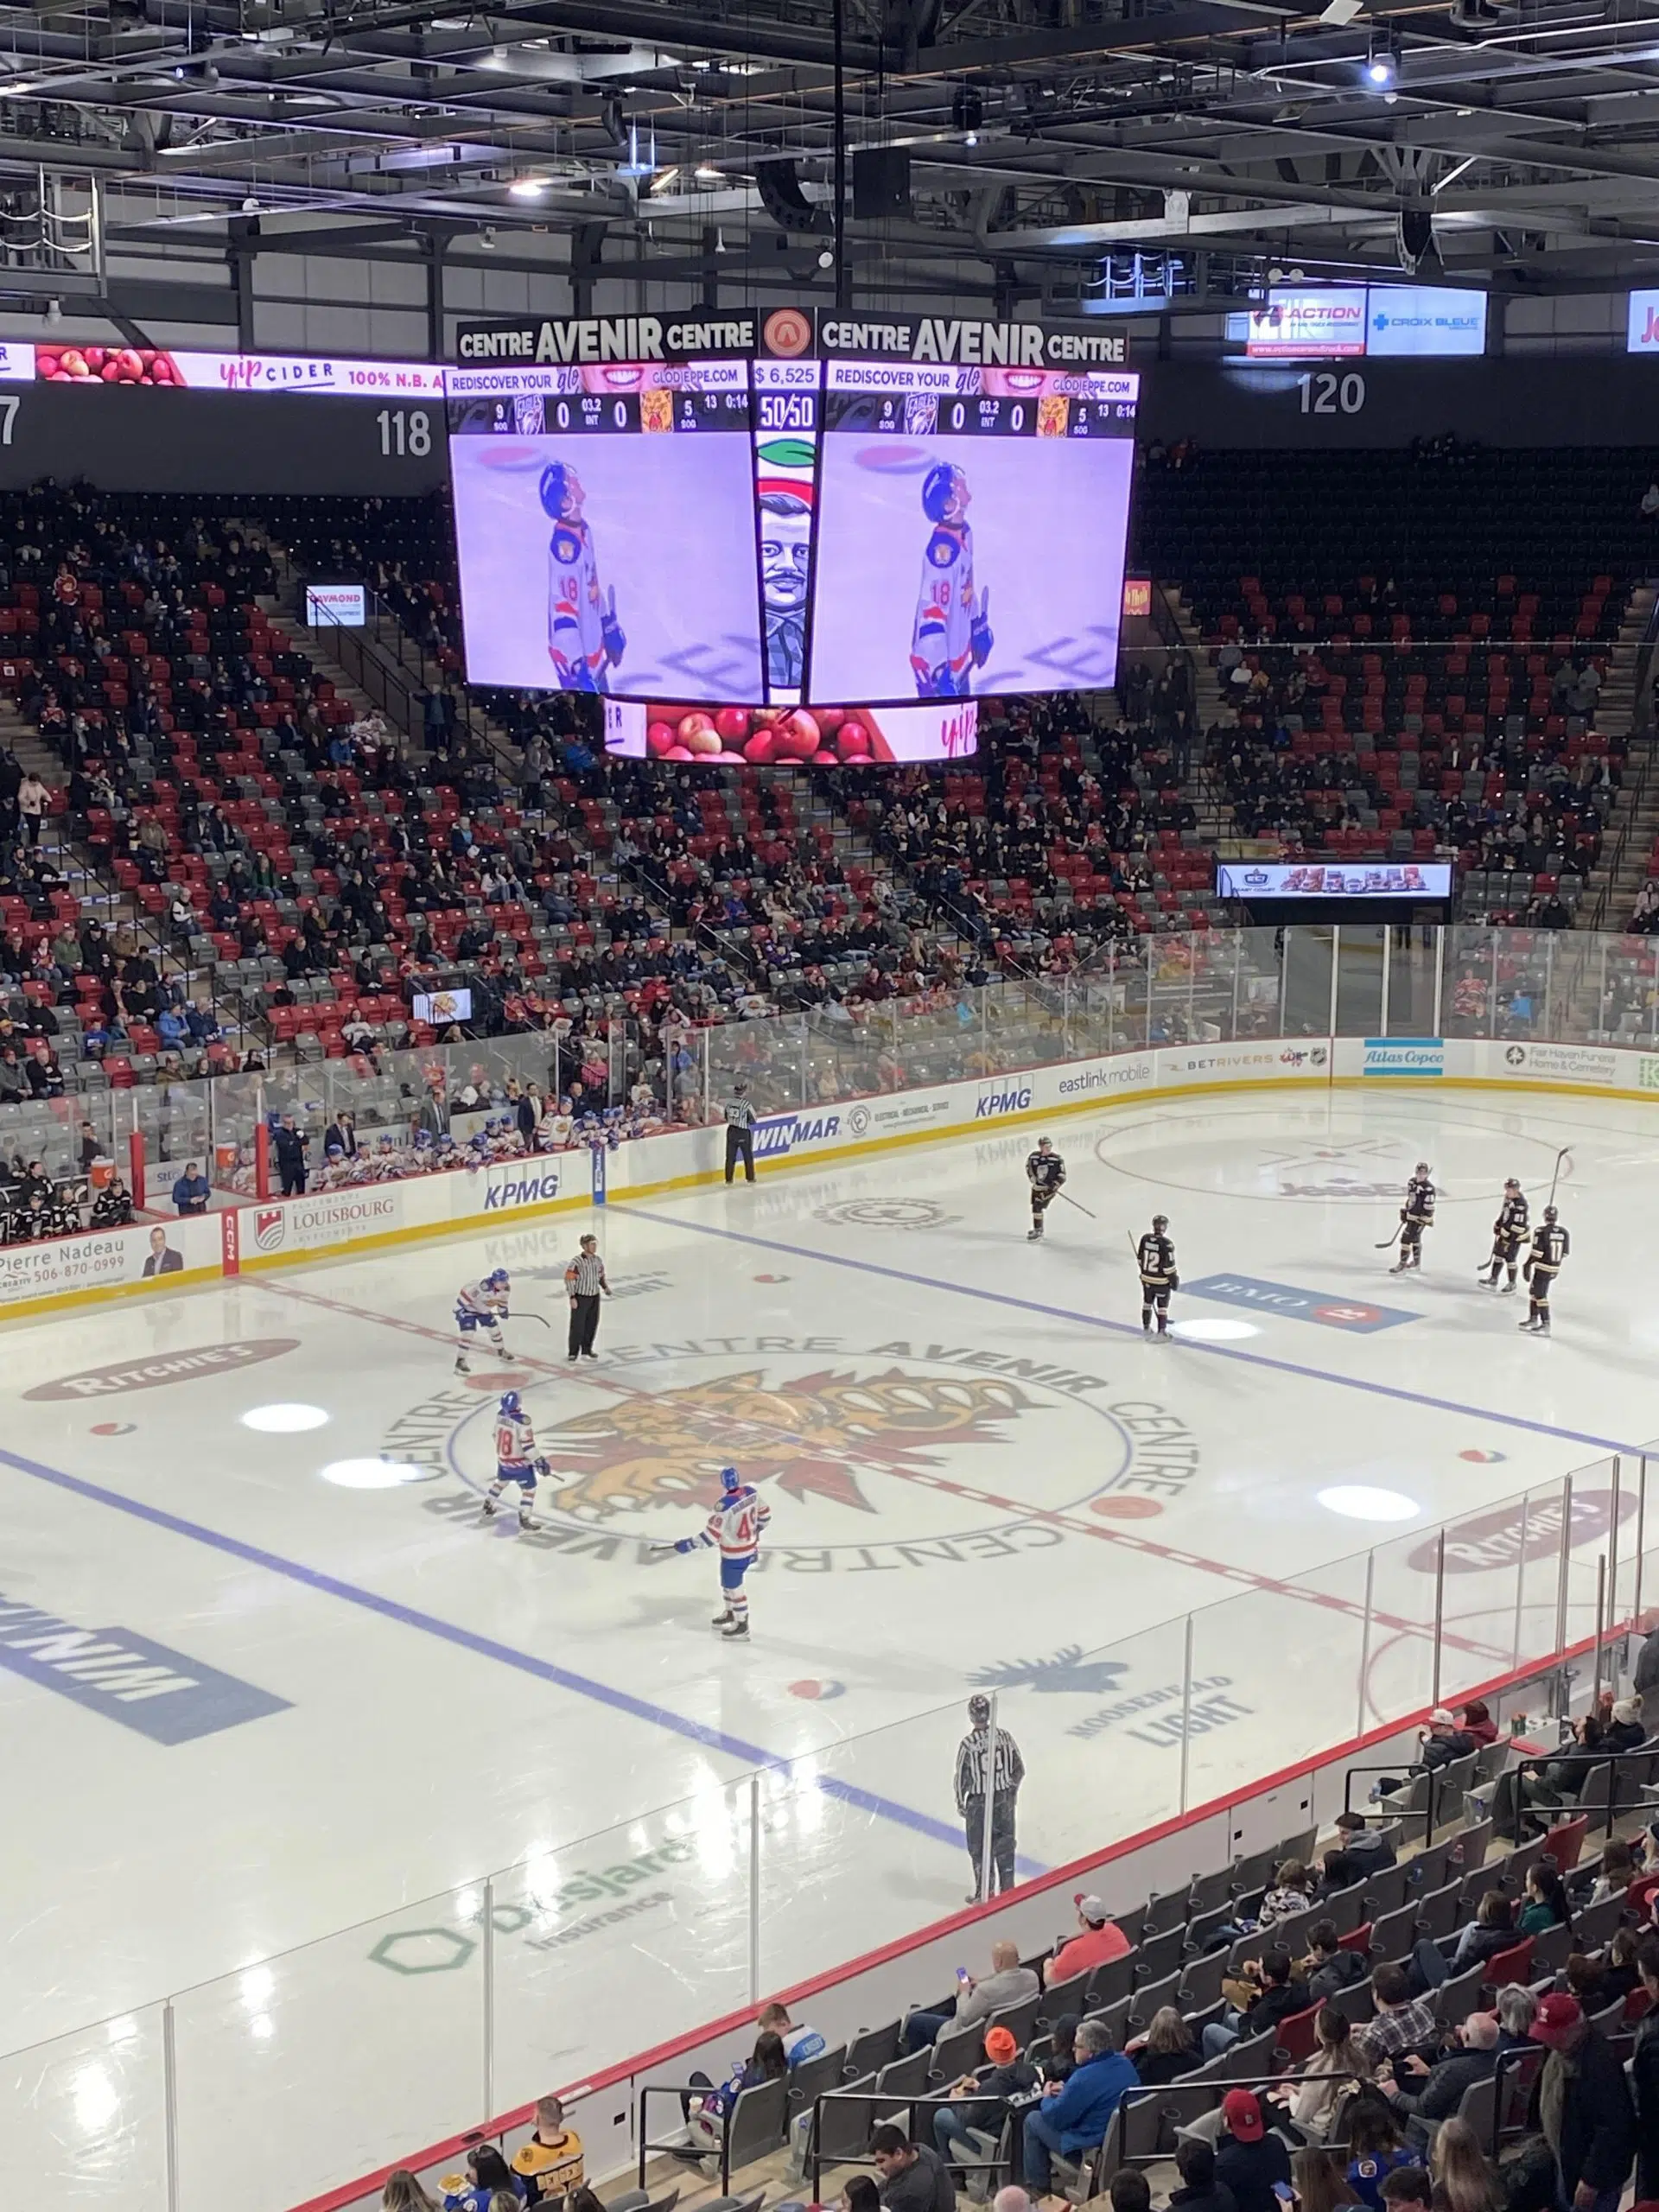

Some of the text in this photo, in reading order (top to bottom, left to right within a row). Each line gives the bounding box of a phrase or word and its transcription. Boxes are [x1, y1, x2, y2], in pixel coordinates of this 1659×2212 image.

[1287, 307, 1362, 319] ACTION
[1391, 317, 1433, 327] CROIX
[1641, 306, 1659, 343] J
[460, 316, 753, 363] CENTRE AVENIR CENTRE
[822, 318, 1124, 365] CENTRE AVENIR CENTRE
[266, 363, 334, 382] CIDER
[348, 371, 391, 387] 100%
[395, 374, 428, 389] N.B.
[452, 375, 519, 390] REDISCOVER
[521, 374, 551, 388] YOUR
[769, 367, 815, 386] 6,525
[835, 369, 914, 386] REDISCOVER
[917, 372, 950, 387] YOUR
[704, 394, 717, 409] 13
[1297, 372, 1366, 414] 120
[495, 404, 504, 420] 9
[556, 402, 569, 429] 0
[614, 401, 626, 428] 0
[684, 400, 693, 416] 5
[760, 394, 814, 430] 50/50
[883, 400, 893, 416] 9
[951, 402, 965, 429] 0
[1011, 404, 1024, 431] 0
[1078, 408, 1087, 423] 5
[377, 410, 431, 457] 118
[560, 575, 578, 601] 18
[931, 582, 950, 605] 18
[1187, 1053, 1274, 1071] BETRIVERS
[1365, 1050, 1444, 1065] Atlas Copco
[1058, 1063, 1150, 1094] eastlink mobile
[975, 1087, 1033, 1118] KPMG
[753, 1116, 841, 1152] WINMAR
[484, 1174, 560, 1210] KPMG
[293, 1198, 394, 1230] LOUISBOURG
[60, 1240, 124, 1262] Nadeau
[224, 1215, 234, 1262] CCM
[1550, 1241, 1563, 1262] 11
[35, 1255, 124, 1283] 506-870-0999
[1143, 1249, 1160, 1273] 12
[1207, 1282, 1310, 1307] BMO
[62, 1344, 254, 1396] RITCHIE'S
[867, 1340, 1109, 1393] AVENIR
[1107, 1401, 1201, 1497] CENTRE
[497, 1427, 513, 1457] 18
[1065, 1675, 1234, 1740] MOOSEHEAD
[1125, 1694, 1255, 1749] LIGHT
[523, 1888, 675, 1952] Insurance
